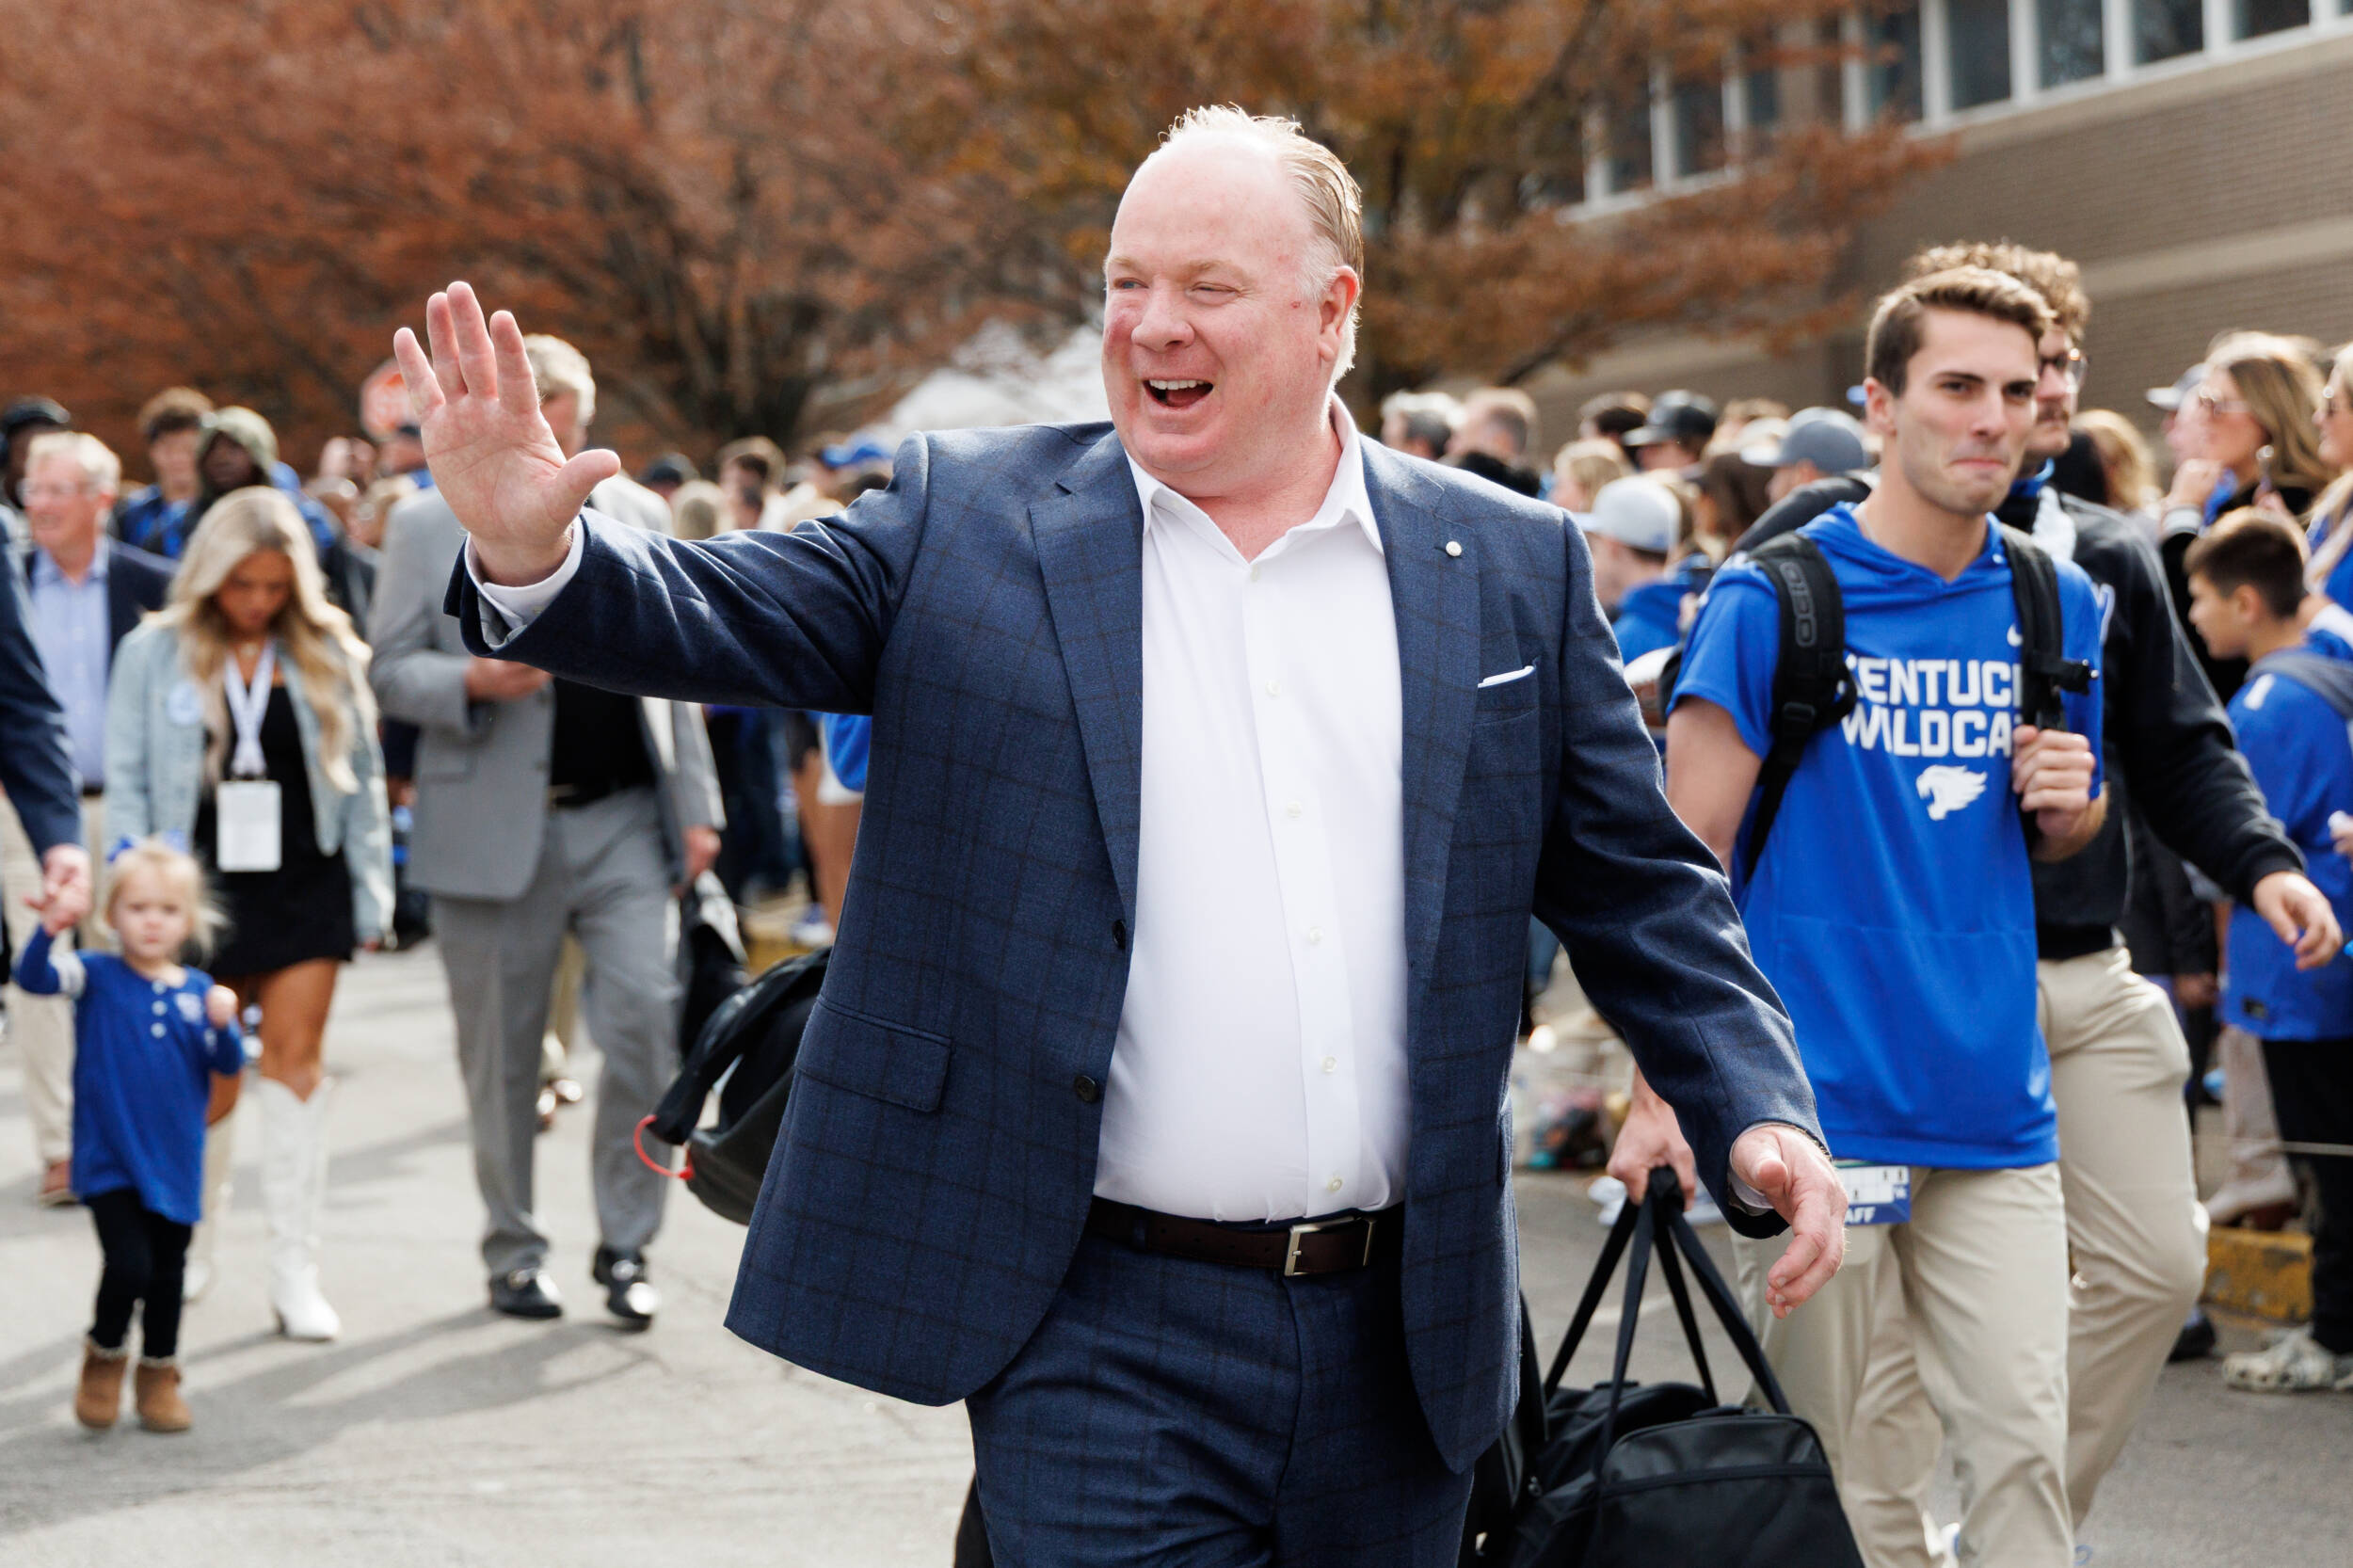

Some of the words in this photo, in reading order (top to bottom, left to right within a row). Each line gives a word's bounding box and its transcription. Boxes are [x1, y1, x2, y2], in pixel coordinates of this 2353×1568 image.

[1837, 653, 2023, 708] ENTUC
[1841, 702, 2023, 758] WILDCA
[1845, 1206, 1876, 1224] AFF
